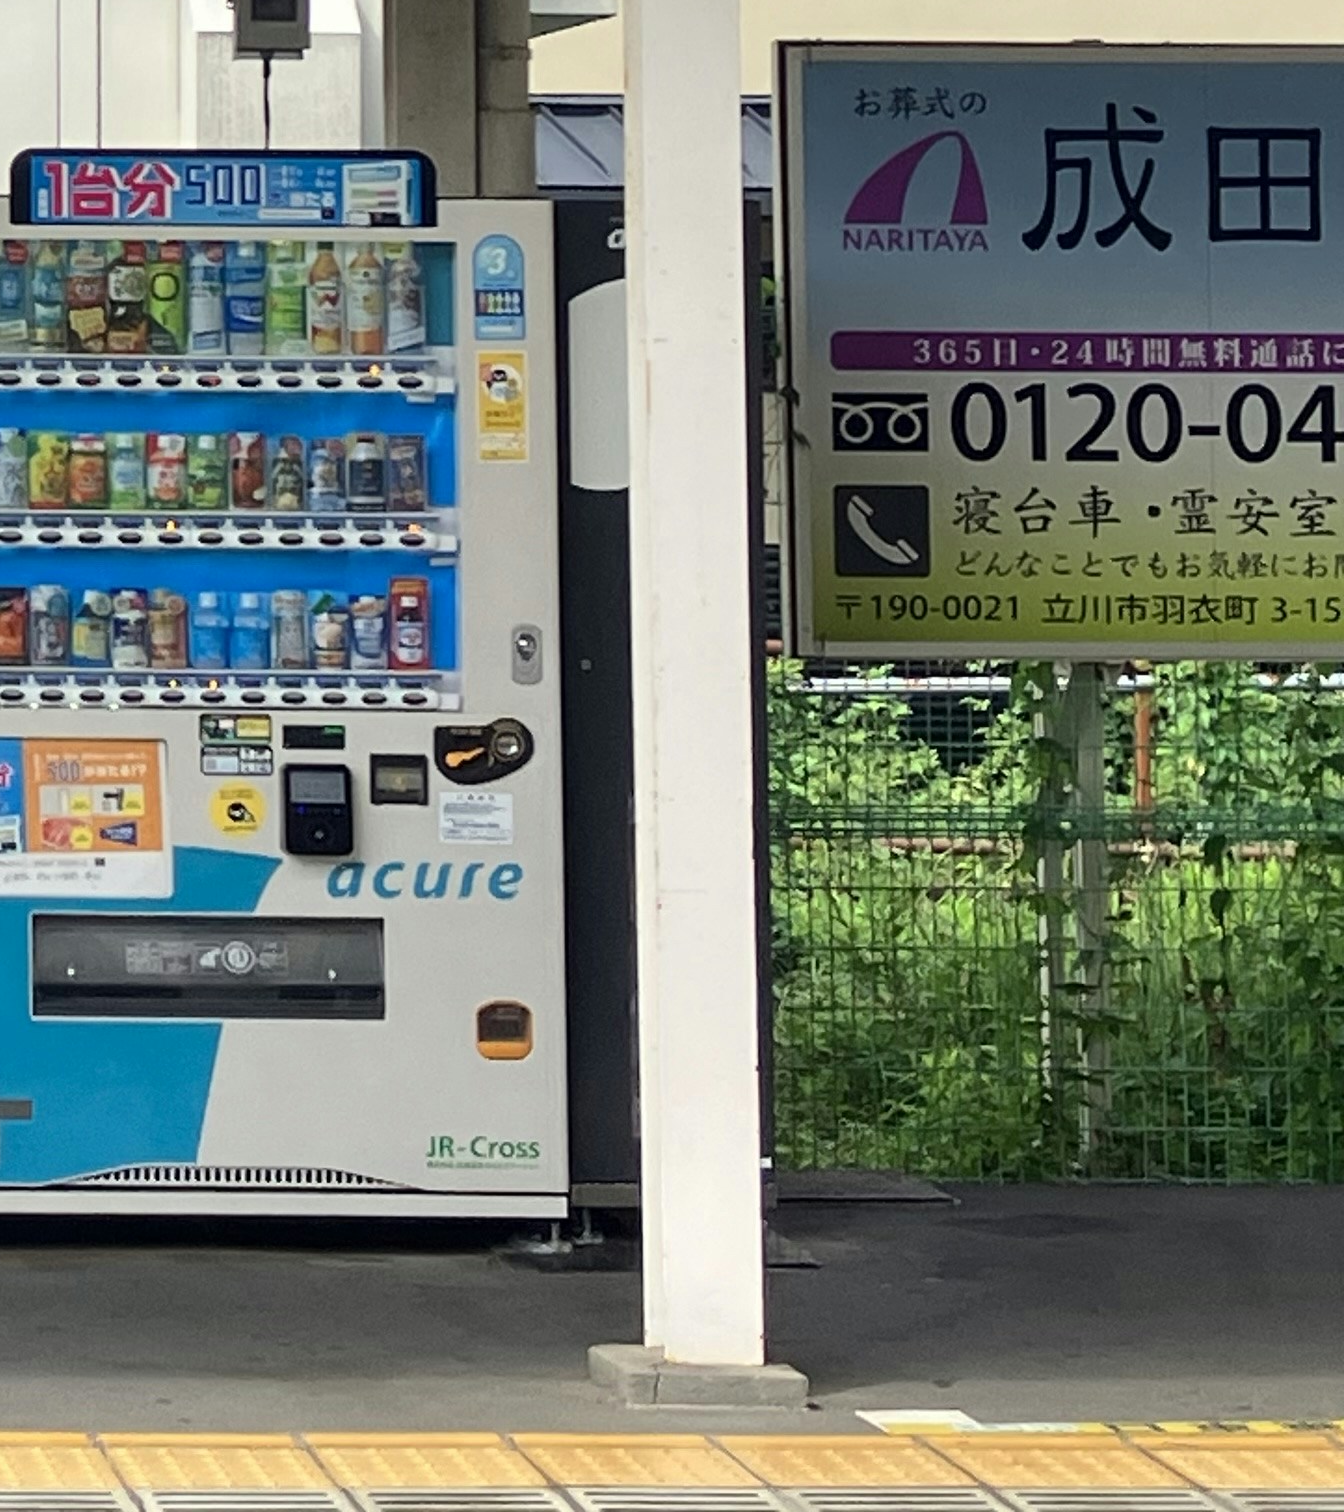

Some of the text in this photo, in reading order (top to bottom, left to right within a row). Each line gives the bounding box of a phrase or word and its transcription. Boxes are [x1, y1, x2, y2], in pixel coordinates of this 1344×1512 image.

[853, 87, 988, 121] お葬式の
[43, 160, 182, 219] 1台分
[1020, 101, 1323, 254] 成田
[842, 227, 991, 254] NARITAYA
[950, 381, 1344, 464] 0120-04
[952, 484, 1339, 539] 寝台車・霊安室
[1040, 591, 1260, 626] 立川市羽衣町
[325, 860, 525, 901] acure
[425, 1134, 541, 1160] JR-Cross
